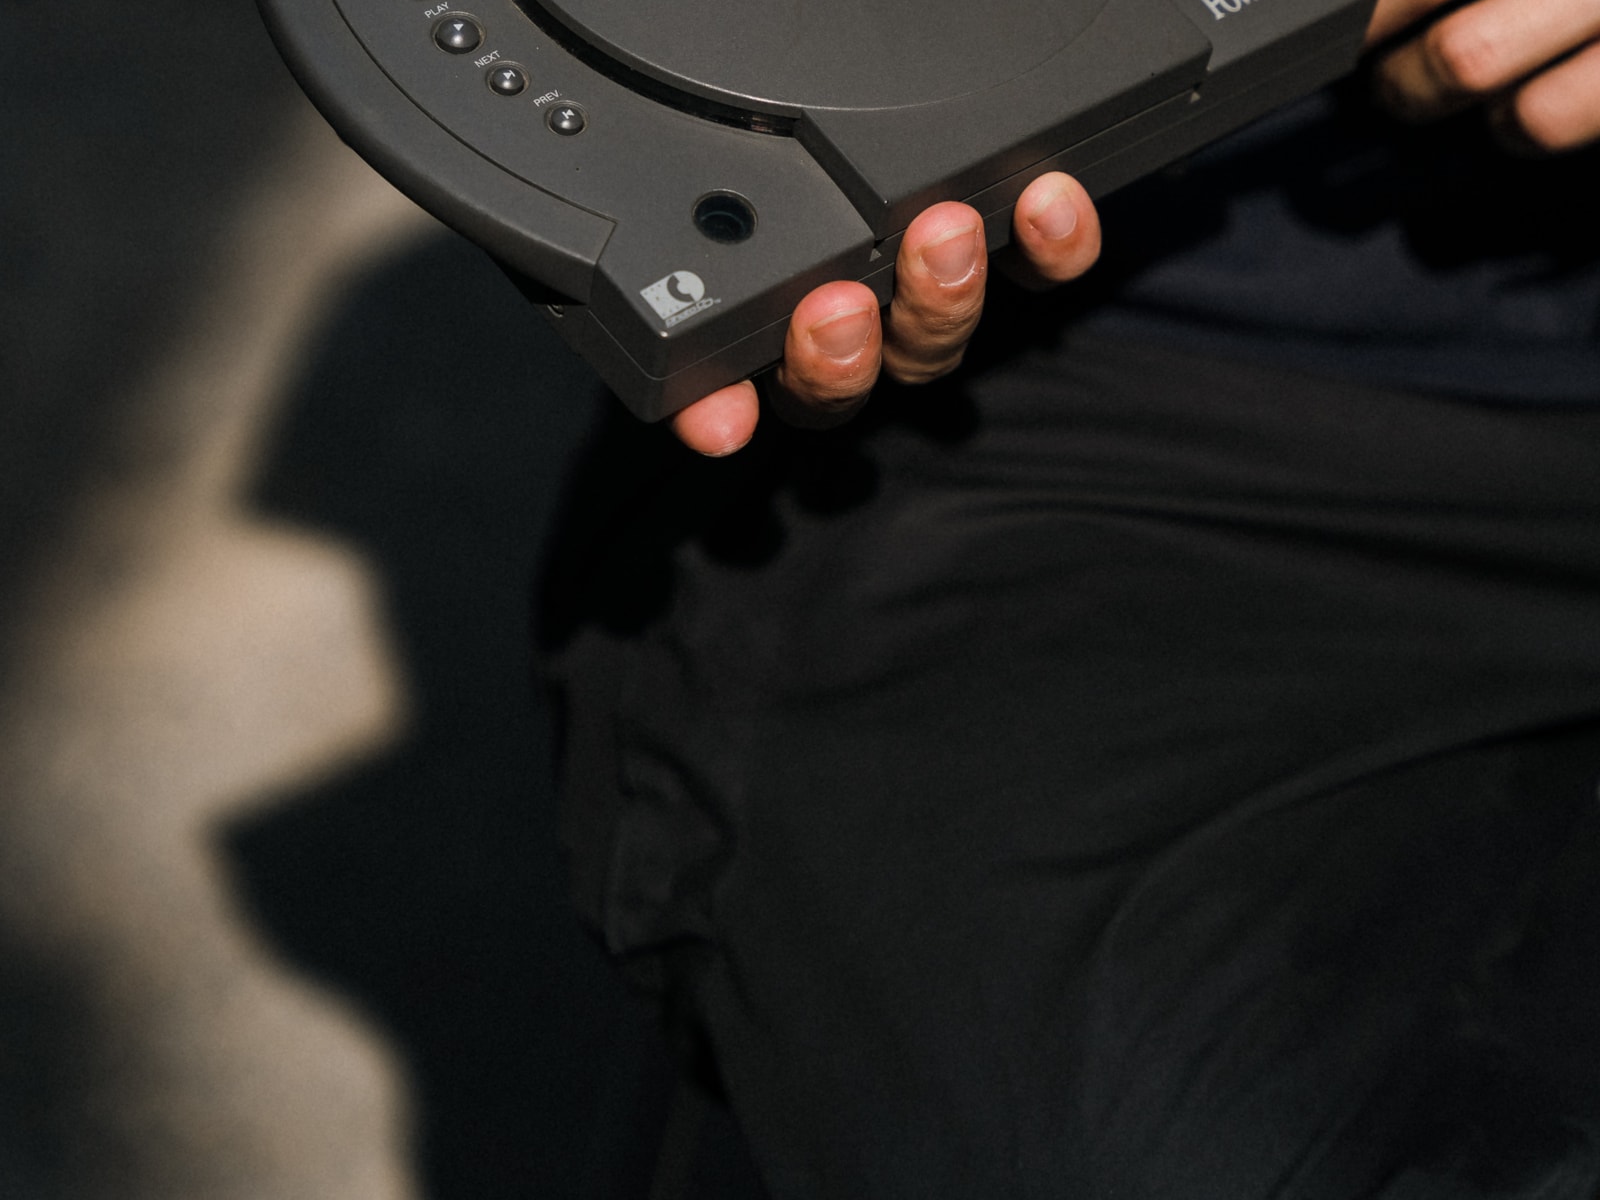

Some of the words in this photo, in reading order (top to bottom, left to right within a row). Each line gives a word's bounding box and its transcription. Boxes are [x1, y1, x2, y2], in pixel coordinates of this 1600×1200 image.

[424, 1, 449, 18] PLAY
[474, 50, 501, 68] NEXT
[533, 89, 562, 107] PREV.
